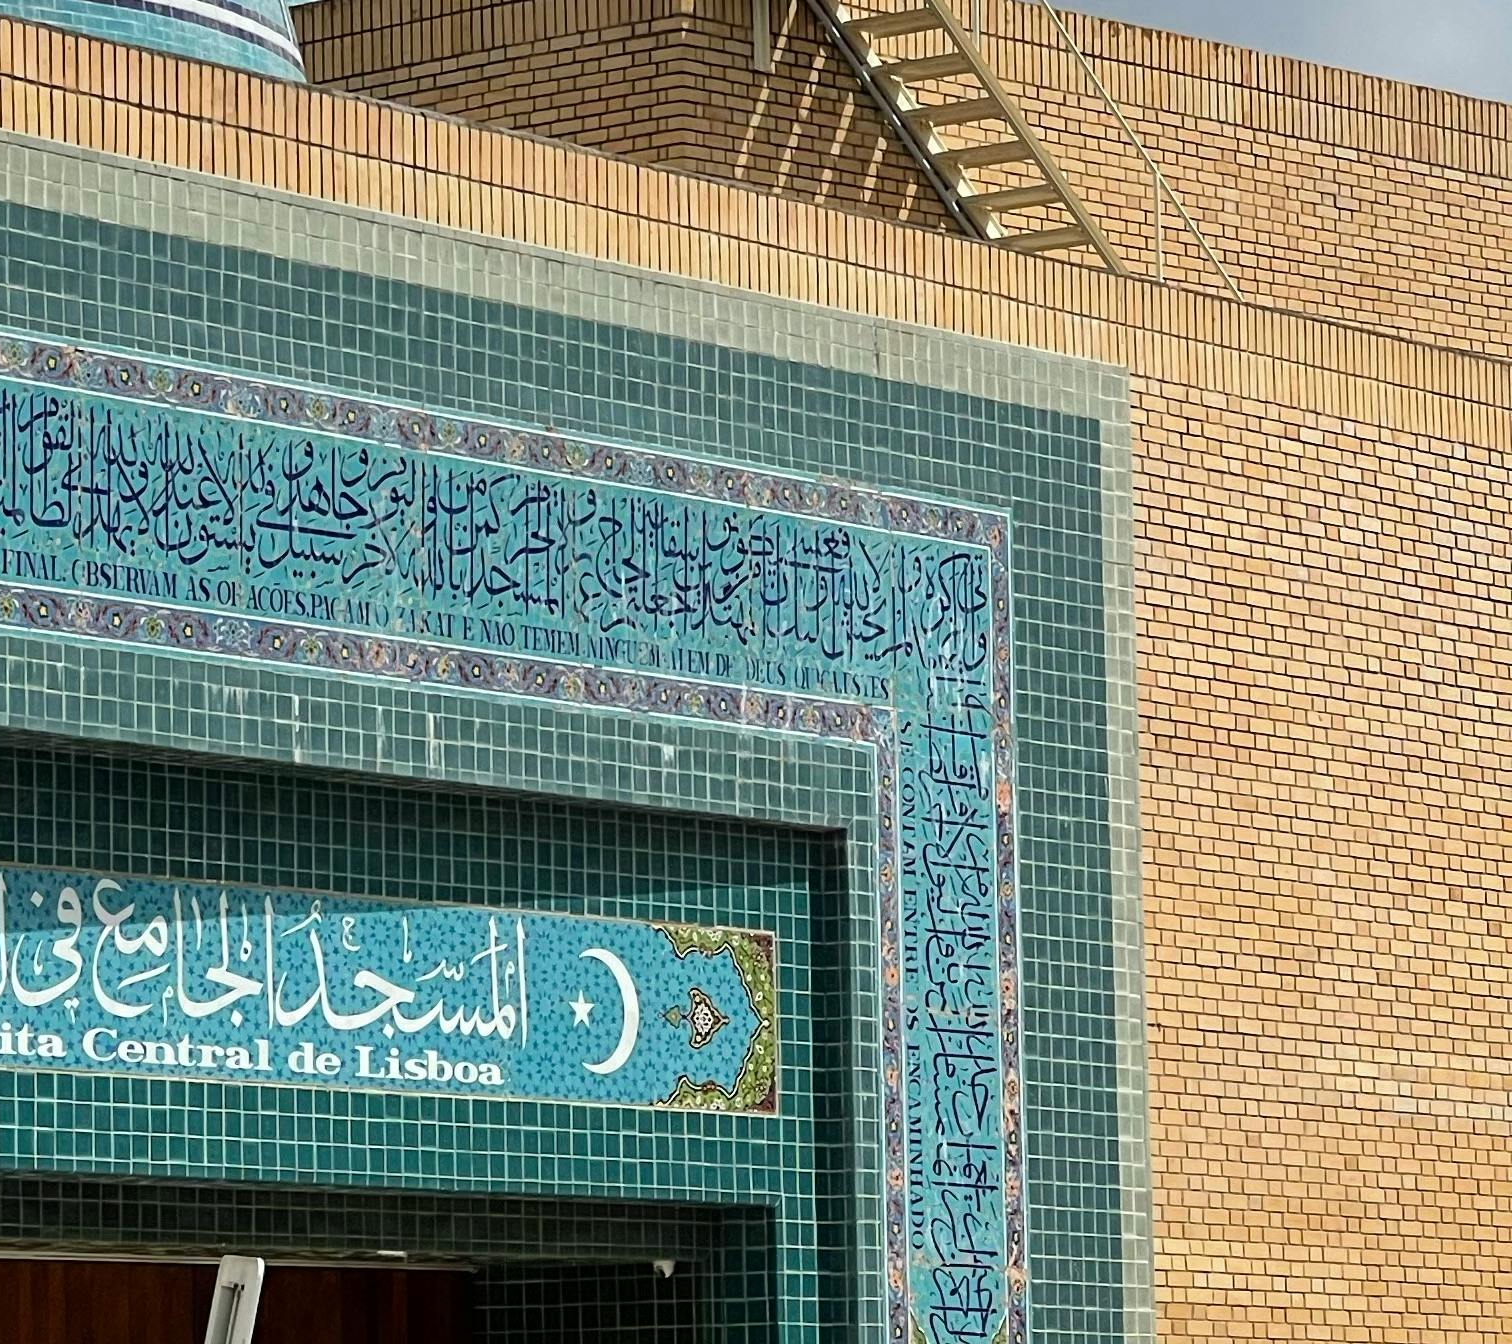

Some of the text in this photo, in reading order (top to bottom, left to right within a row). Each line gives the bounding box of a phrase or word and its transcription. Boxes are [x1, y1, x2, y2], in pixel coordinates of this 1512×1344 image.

[185, 575, 212, 602] AS
[463, 615, 475, 641] E
[520, 624, 580, 657] TEMEM
[744, 656, 787, 686] DEUS
[901, 766, 917, 877] CONTAM
[11, 887, 84, 1009] في
[903, 888, 919, 984] ENTRE
[81, 1027, 274, 1071] Central
[288, 1041, 342, 1076] de
[354, 1045, 506, 1086] Lisboa
